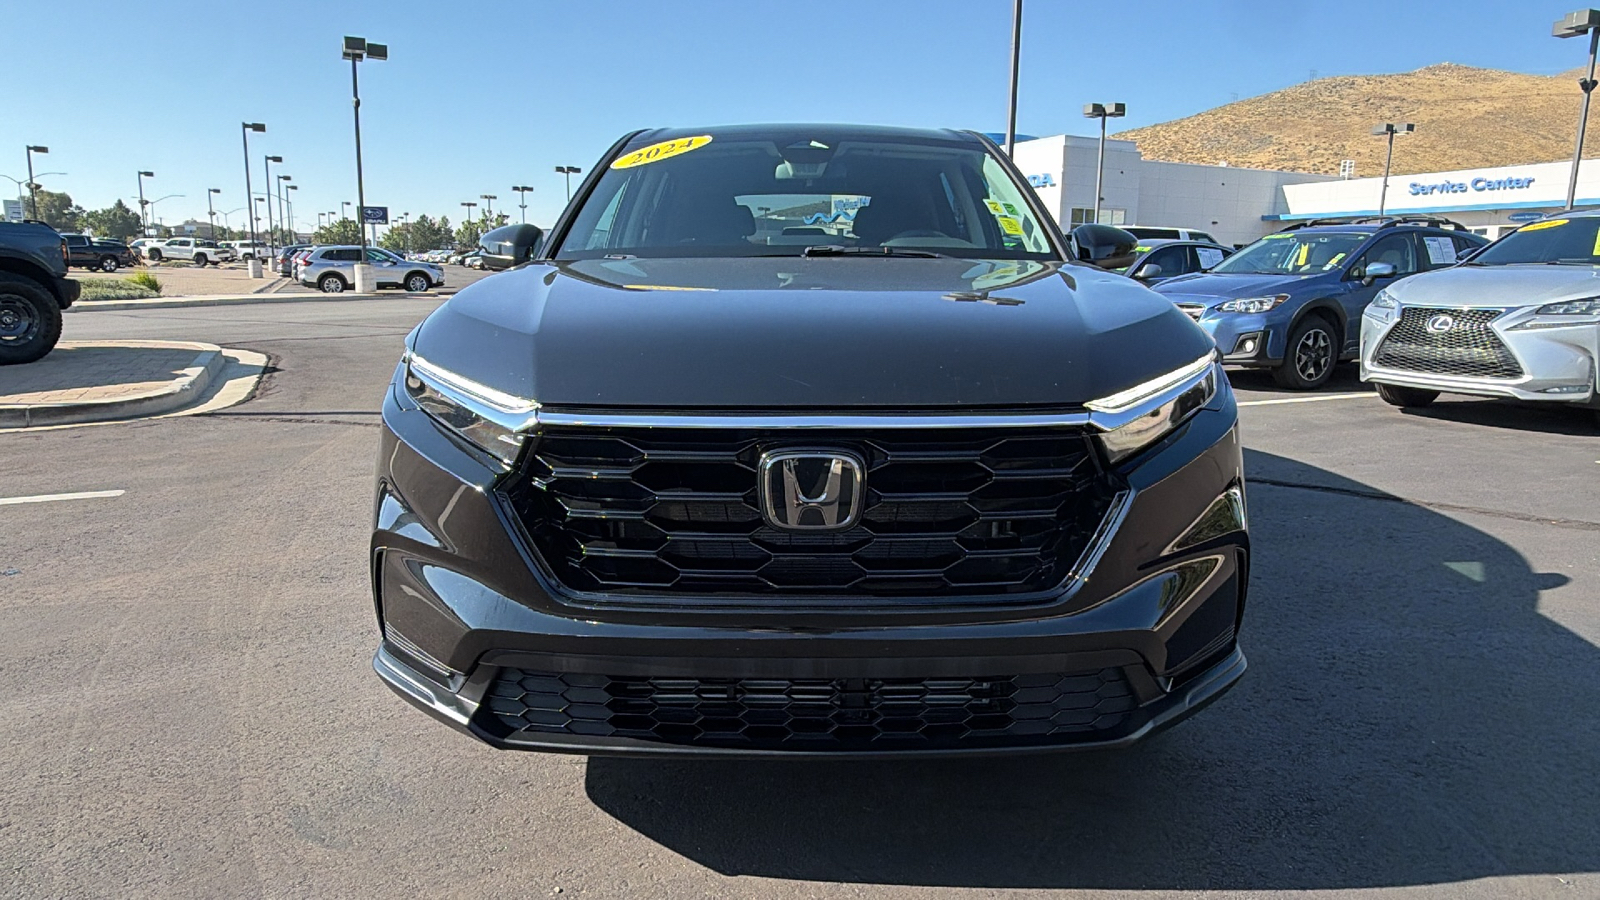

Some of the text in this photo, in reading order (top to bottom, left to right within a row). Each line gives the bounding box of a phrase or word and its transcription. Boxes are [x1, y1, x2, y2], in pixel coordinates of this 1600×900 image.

[629, 138, 694, 165] 2024
[1409, 176, 1535, 195] Service Center
